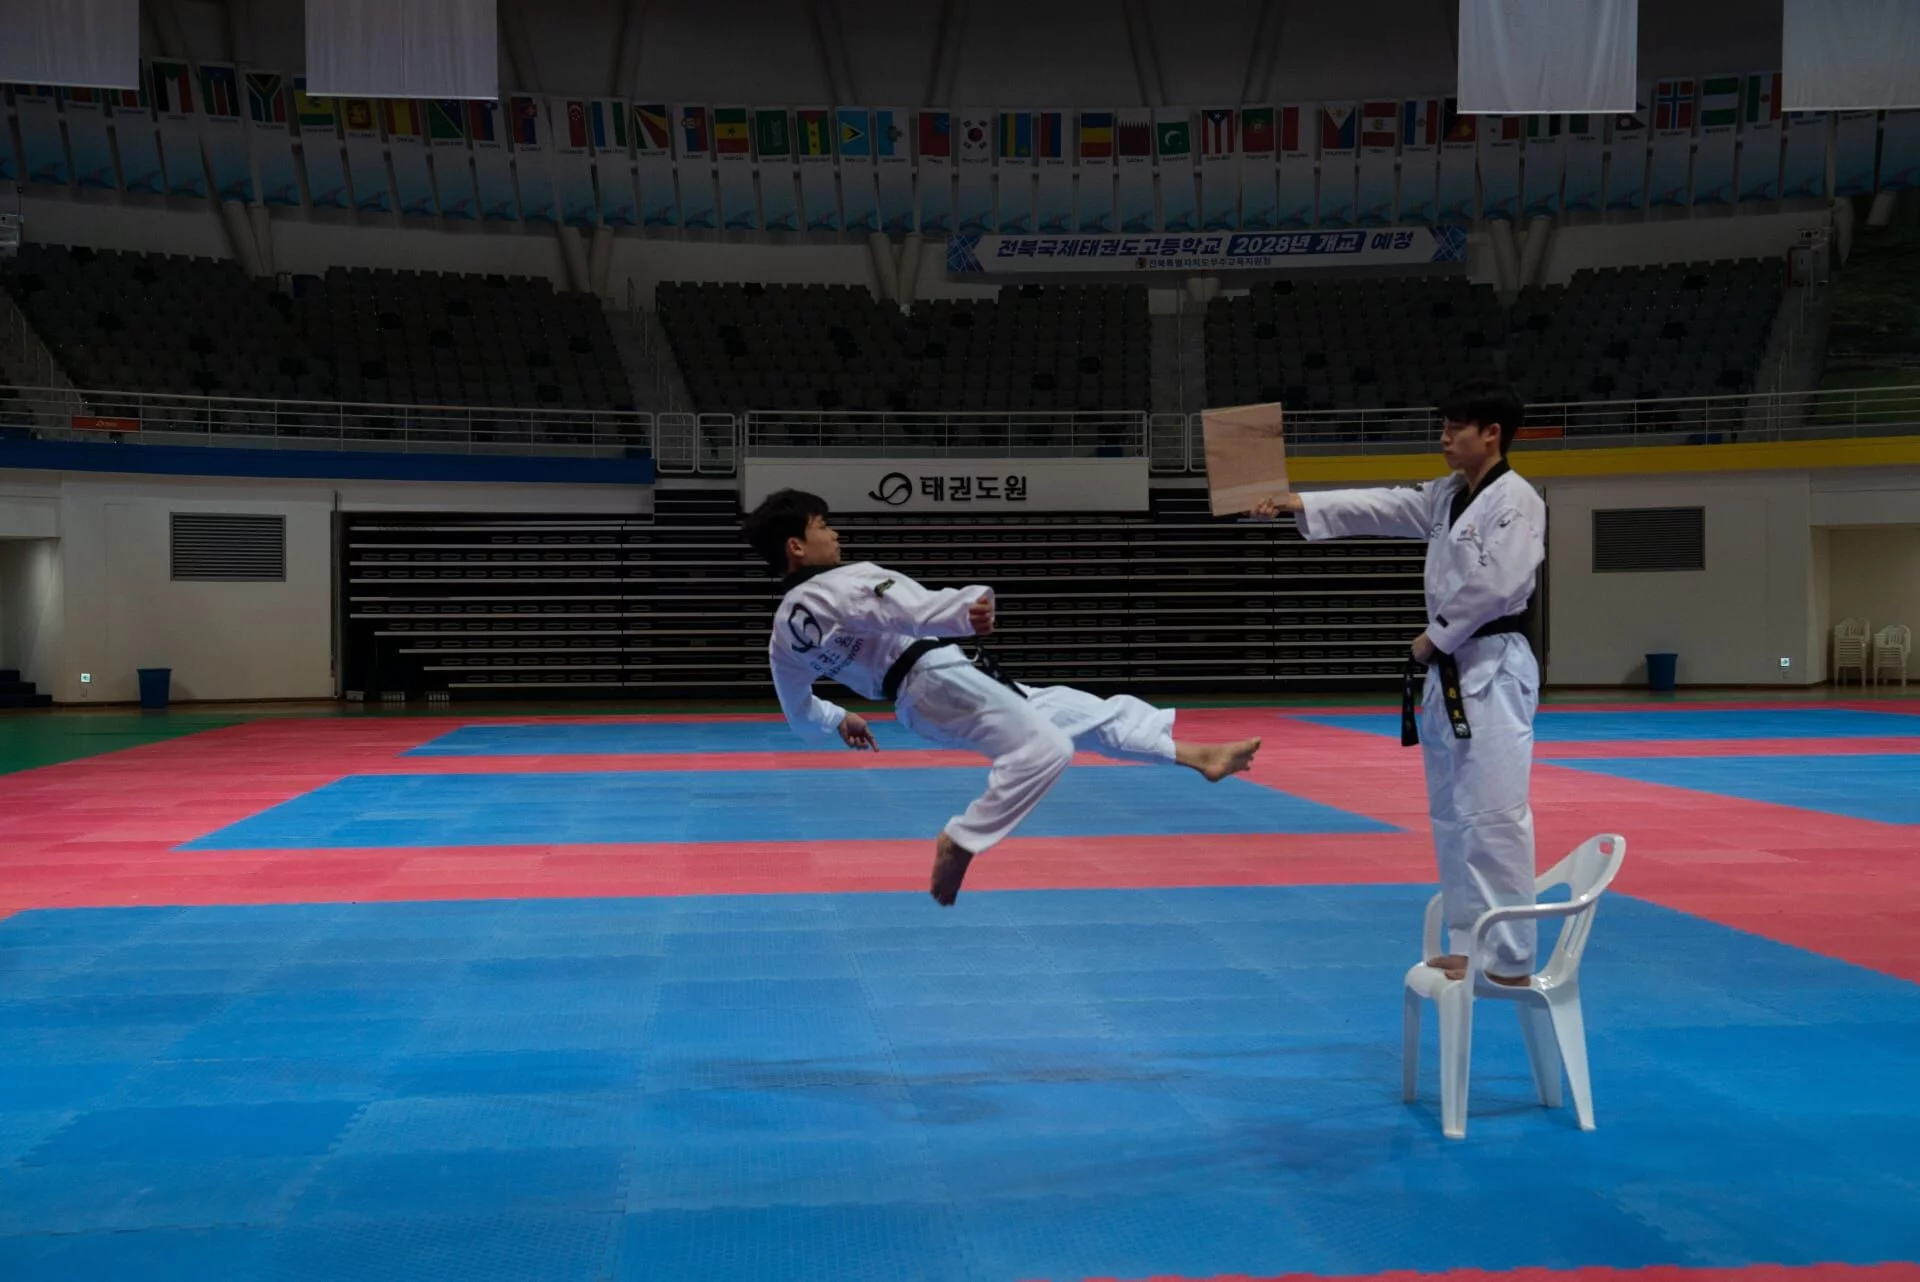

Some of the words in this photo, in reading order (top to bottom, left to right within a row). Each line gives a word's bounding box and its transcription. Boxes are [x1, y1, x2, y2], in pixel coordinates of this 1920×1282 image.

[997, 236, 1222, 258] 전북국제태권도고등학교
[1233, 234, 1310, 254] 2028년
[1316, 232, 1358, 252] 개교
[1371, 231, 1414, 251] 예정
[919, 475, 1028, 502] 태권도원
